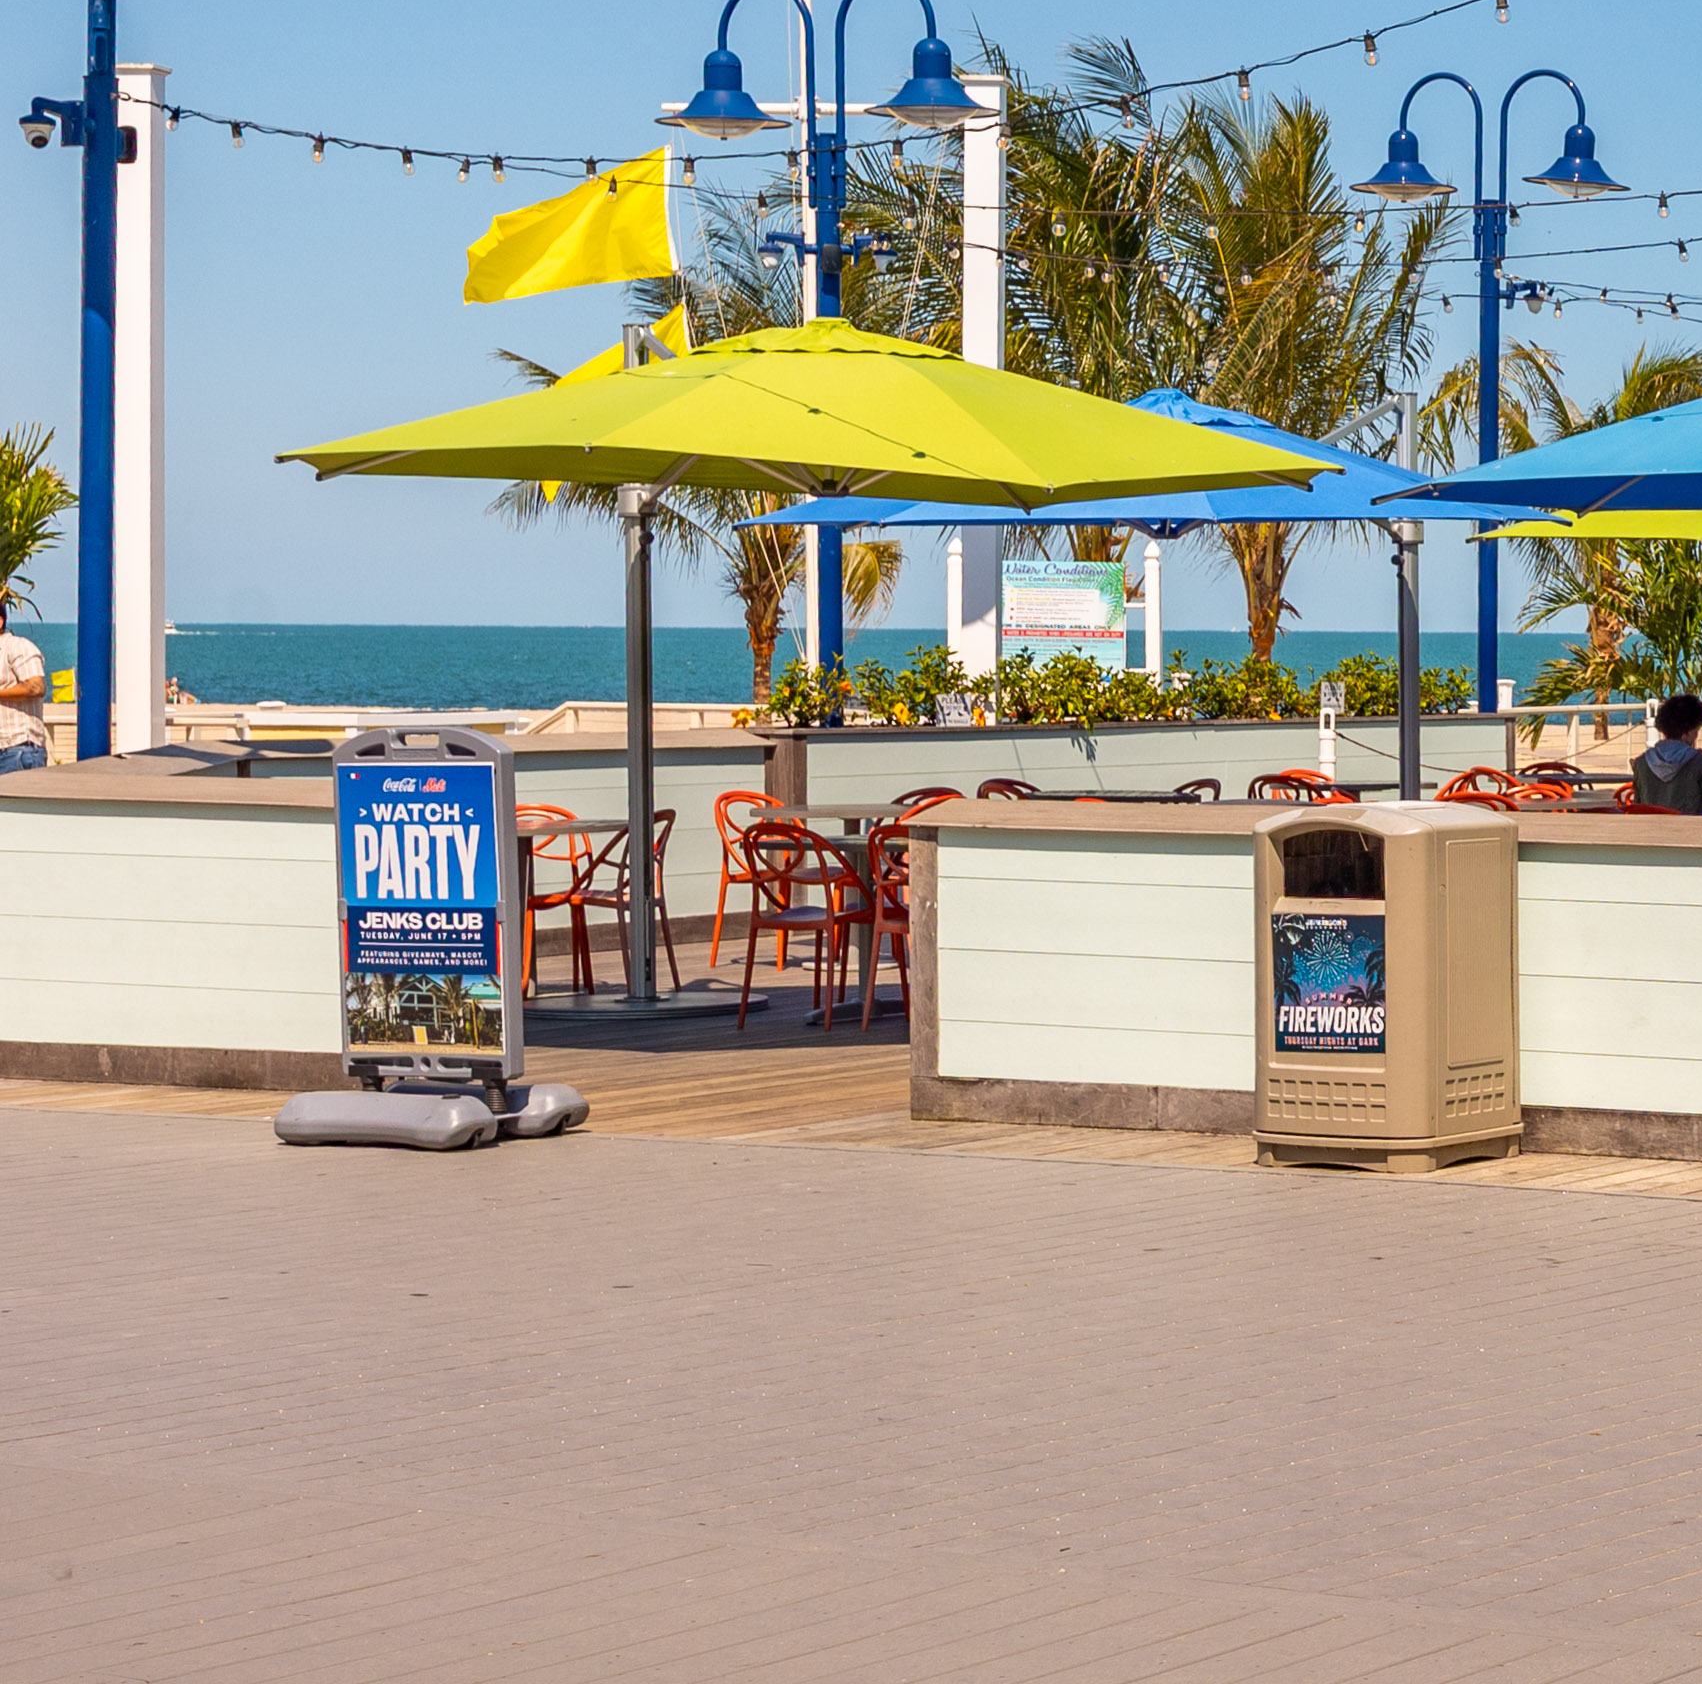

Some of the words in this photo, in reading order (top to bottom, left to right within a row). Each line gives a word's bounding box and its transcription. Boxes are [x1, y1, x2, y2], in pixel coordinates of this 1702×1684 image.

[371, 802, 461, 822] WATCH
[354, 824, 481, 901] PARTY
[358, 911, 423, 930] JENKS
[425, 912, 483, 931] CLUB
[360, 931, 404, 941] TUESDAY,
[407, 932, 433, 940] JUNE
[437, 932, 447, 940] 17
[1278, 1005, 1385, 1034] FIREWORKS
